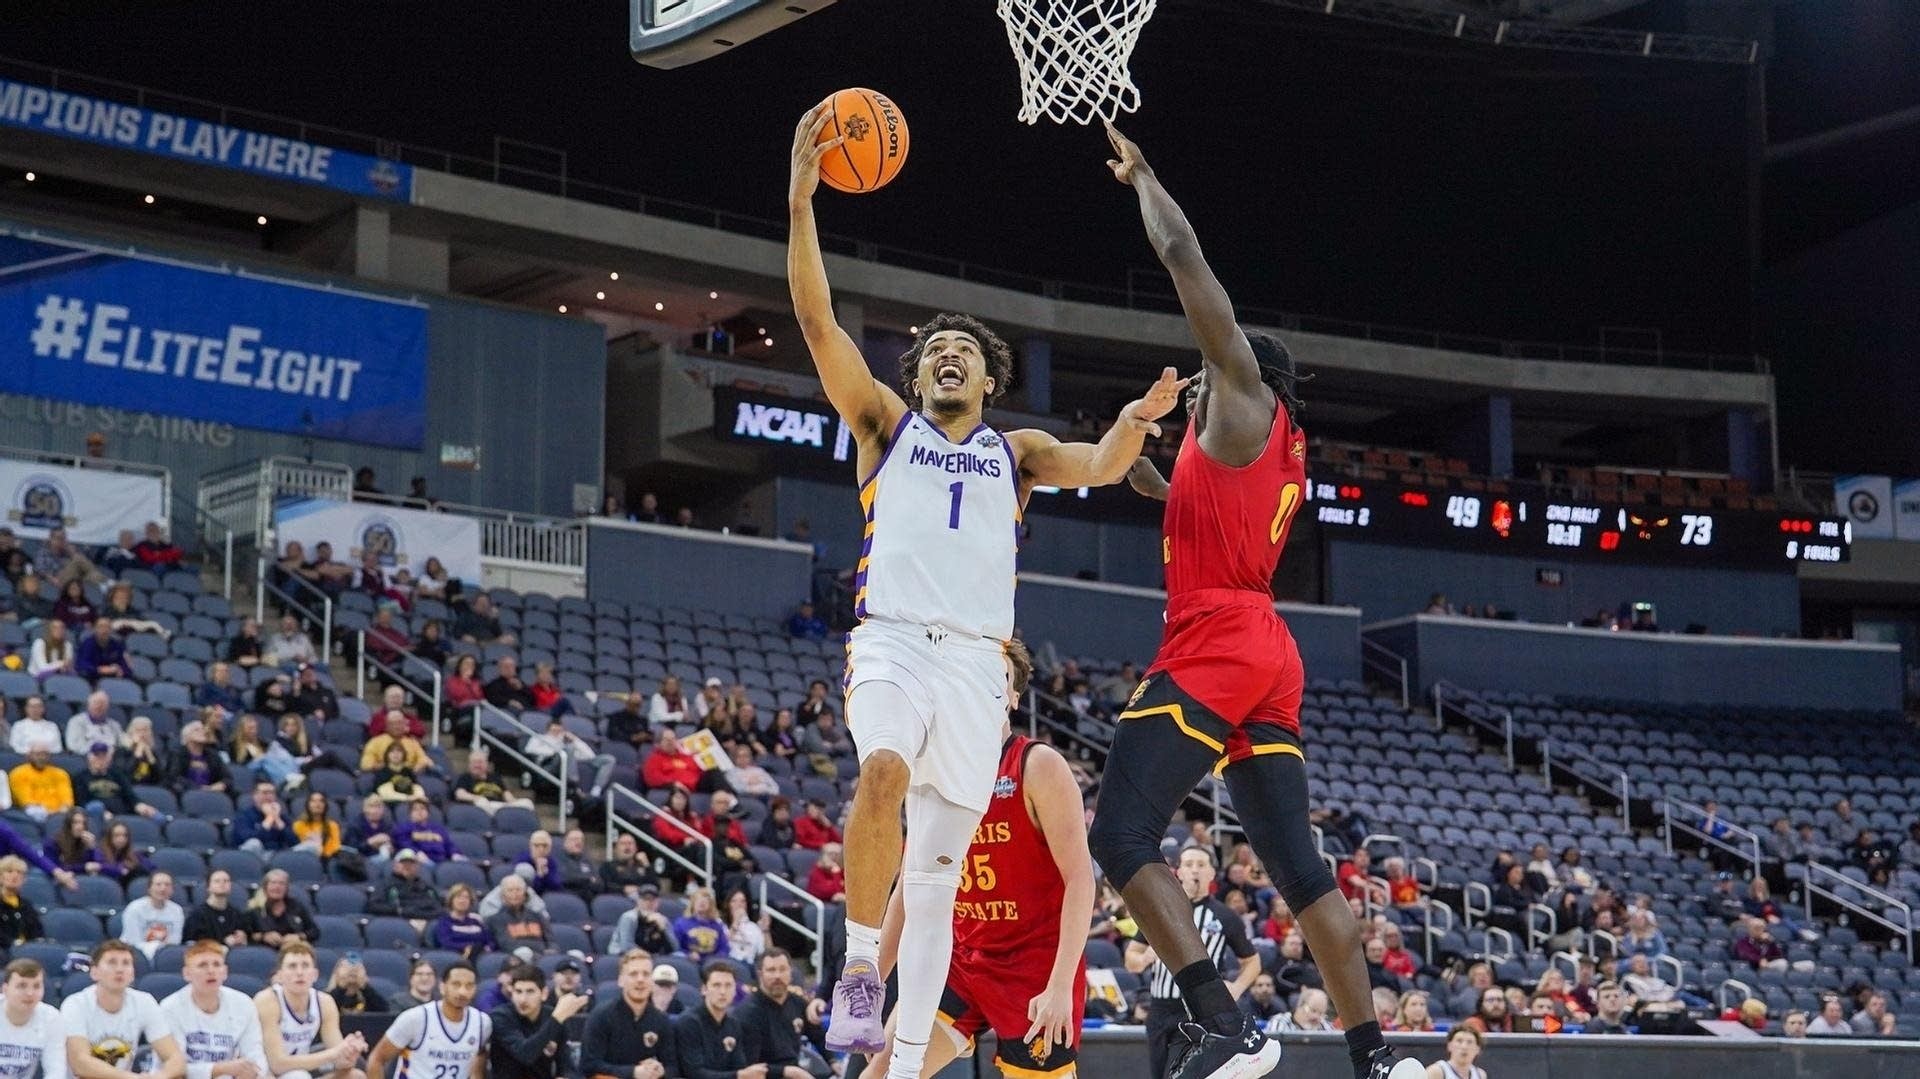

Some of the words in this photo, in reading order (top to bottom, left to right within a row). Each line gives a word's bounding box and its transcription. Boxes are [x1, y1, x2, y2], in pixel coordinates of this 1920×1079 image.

[146, 112, 240, 163] PLAY
[242, 133, 333, 182] HERE
[873, 94, 899, 161] Wilson
[734, 402, 823, 447] NCAA
[910, 445, 1001, 478] MAVERICKS
[949, 481, 964, 530] 1
[1269, 482, 1301, 545] 0
[1446, 495, 1480, 528] 49
[1680, 514, 1713, 546] 73
[954, 900, 1019, 921] STATE
[435, 1064, 459, 1079] 23
